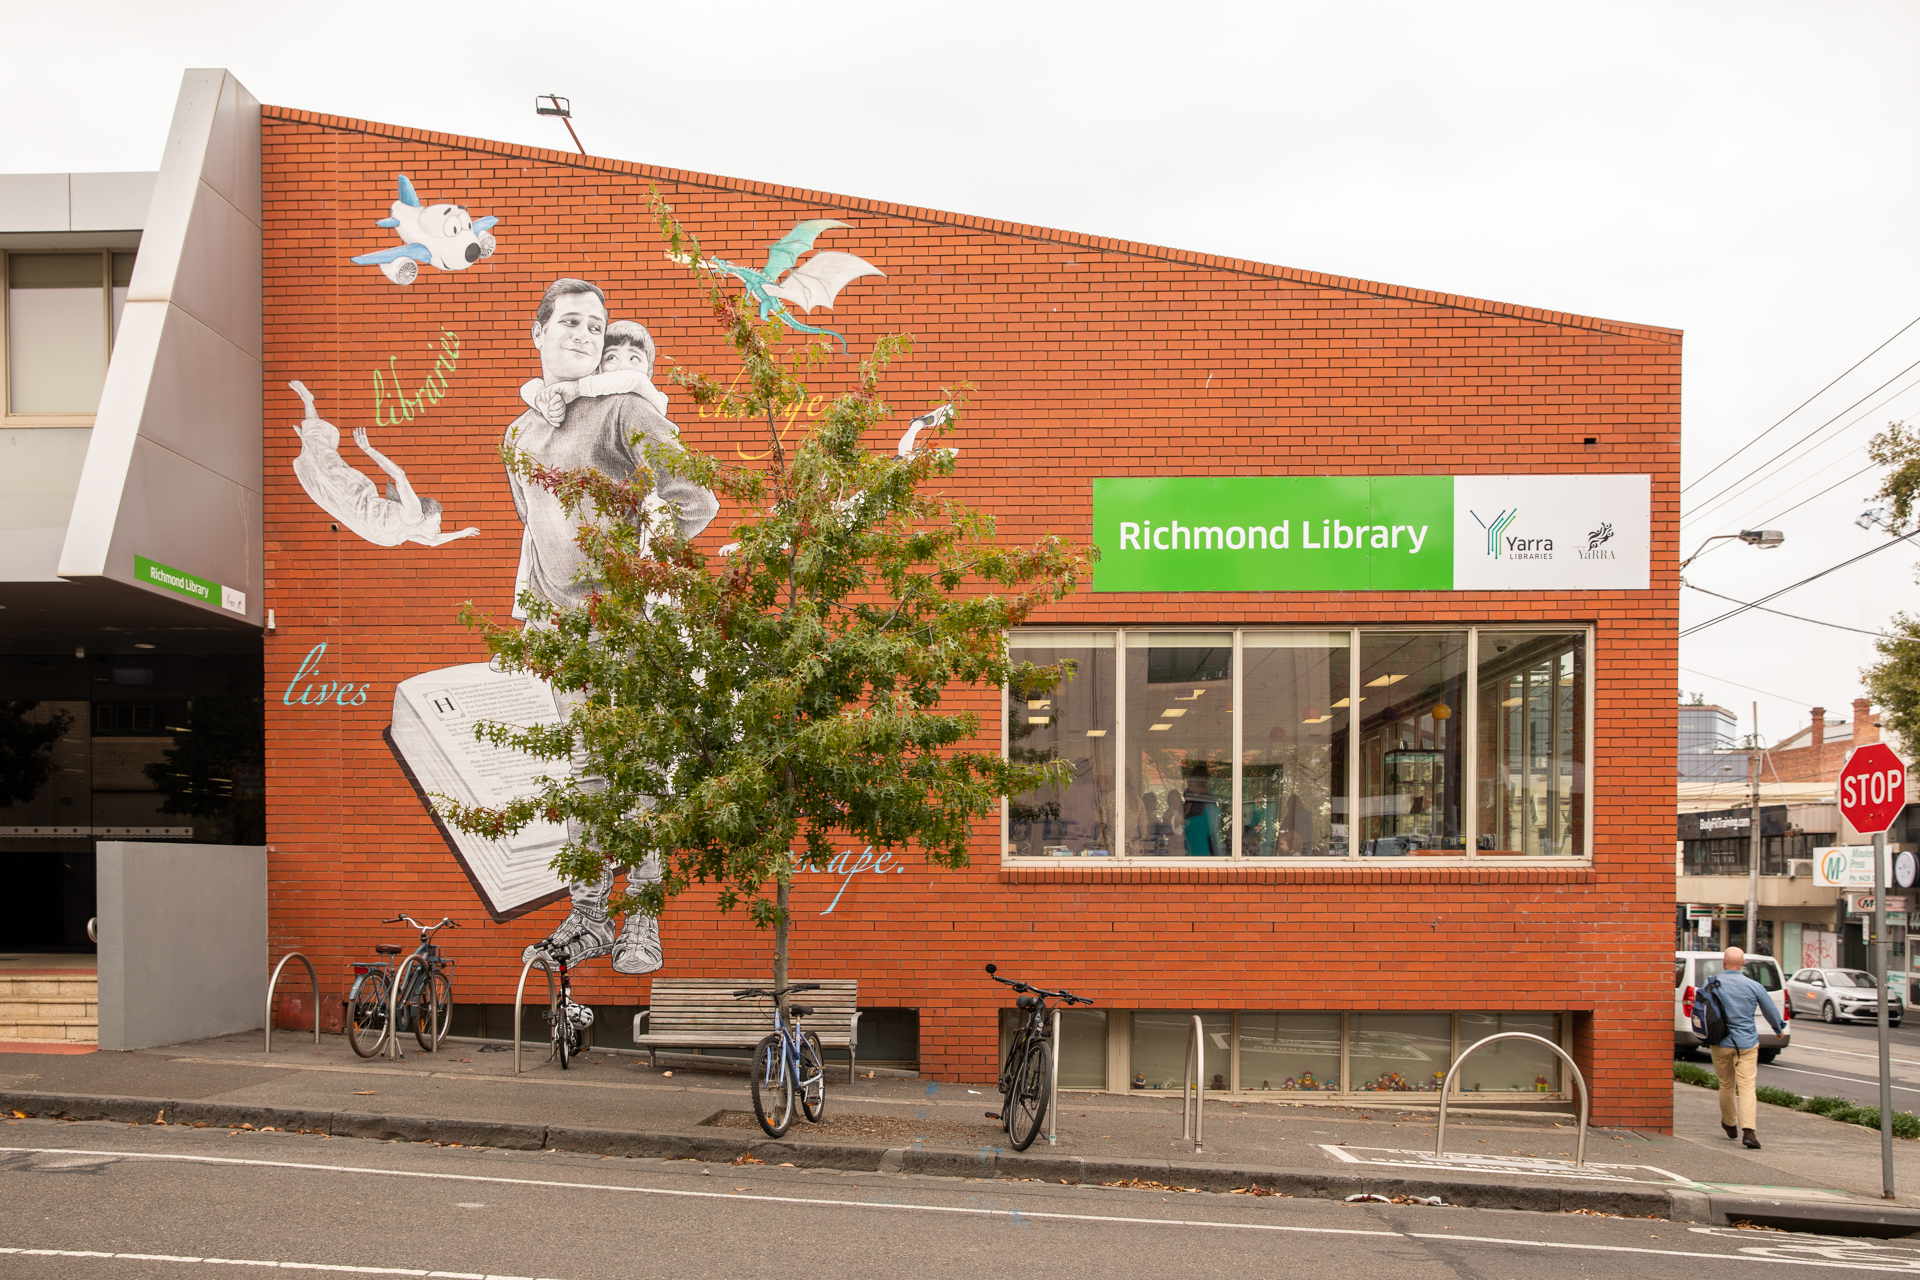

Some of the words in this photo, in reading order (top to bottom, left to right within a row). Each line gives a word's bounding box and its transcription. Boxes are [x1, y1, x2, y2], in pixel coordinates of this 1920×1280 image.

[373, 325, 460, 426] libraries
[1120, 519, 1290, 550] Richmond
[1302, 518, 1429, 554] Library
[1506, 536, 1553, 551] Yarra
[150, 566, 184, 589] Richmond
[185, 578, 209, 599] Library
[283, 642, 370, 706] lives
[433, 697, 456, 715] H
[1843, 769, 1902, 809] STOP
[787, 845, 905, 916] scape.
